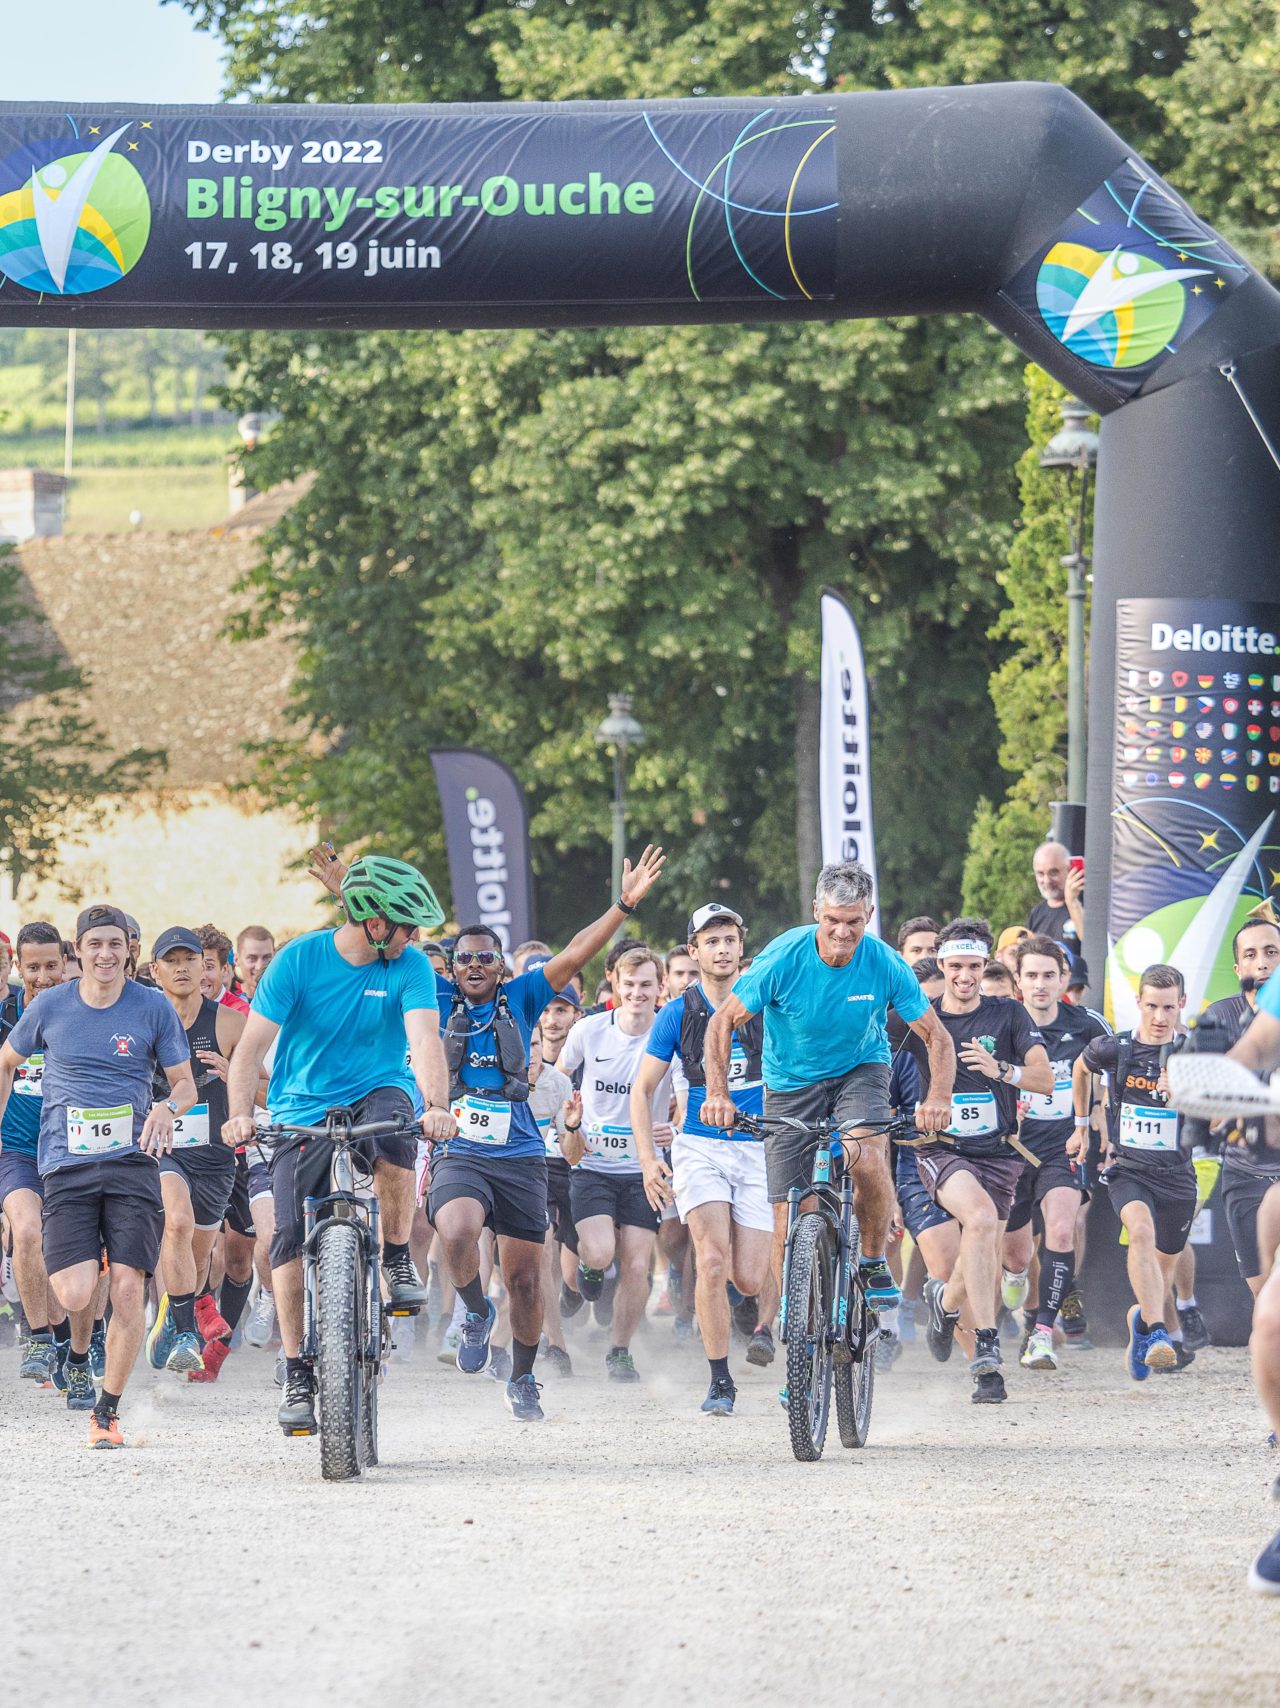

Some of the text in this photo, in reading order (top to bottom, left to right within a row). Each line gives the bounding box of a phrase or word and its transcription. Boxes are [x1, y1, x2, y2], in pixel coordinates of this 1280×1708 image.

[187, 140, 383, 170] Derby 2022
[186, 172, 655, 232] Bligny-sur-Ouche
[184, 239, 441, 277] 17, 18, 19 juin
[595, 1079, 632, 1095] Deloi
[469, 1112, 490, 1128] 98
[960, 1107, 980, 1121] 85
[90, 1123, 112, 1137] 16
[1135, 1120, 1161, 1135] 111
[602, 1136, 628, 1149] 103
